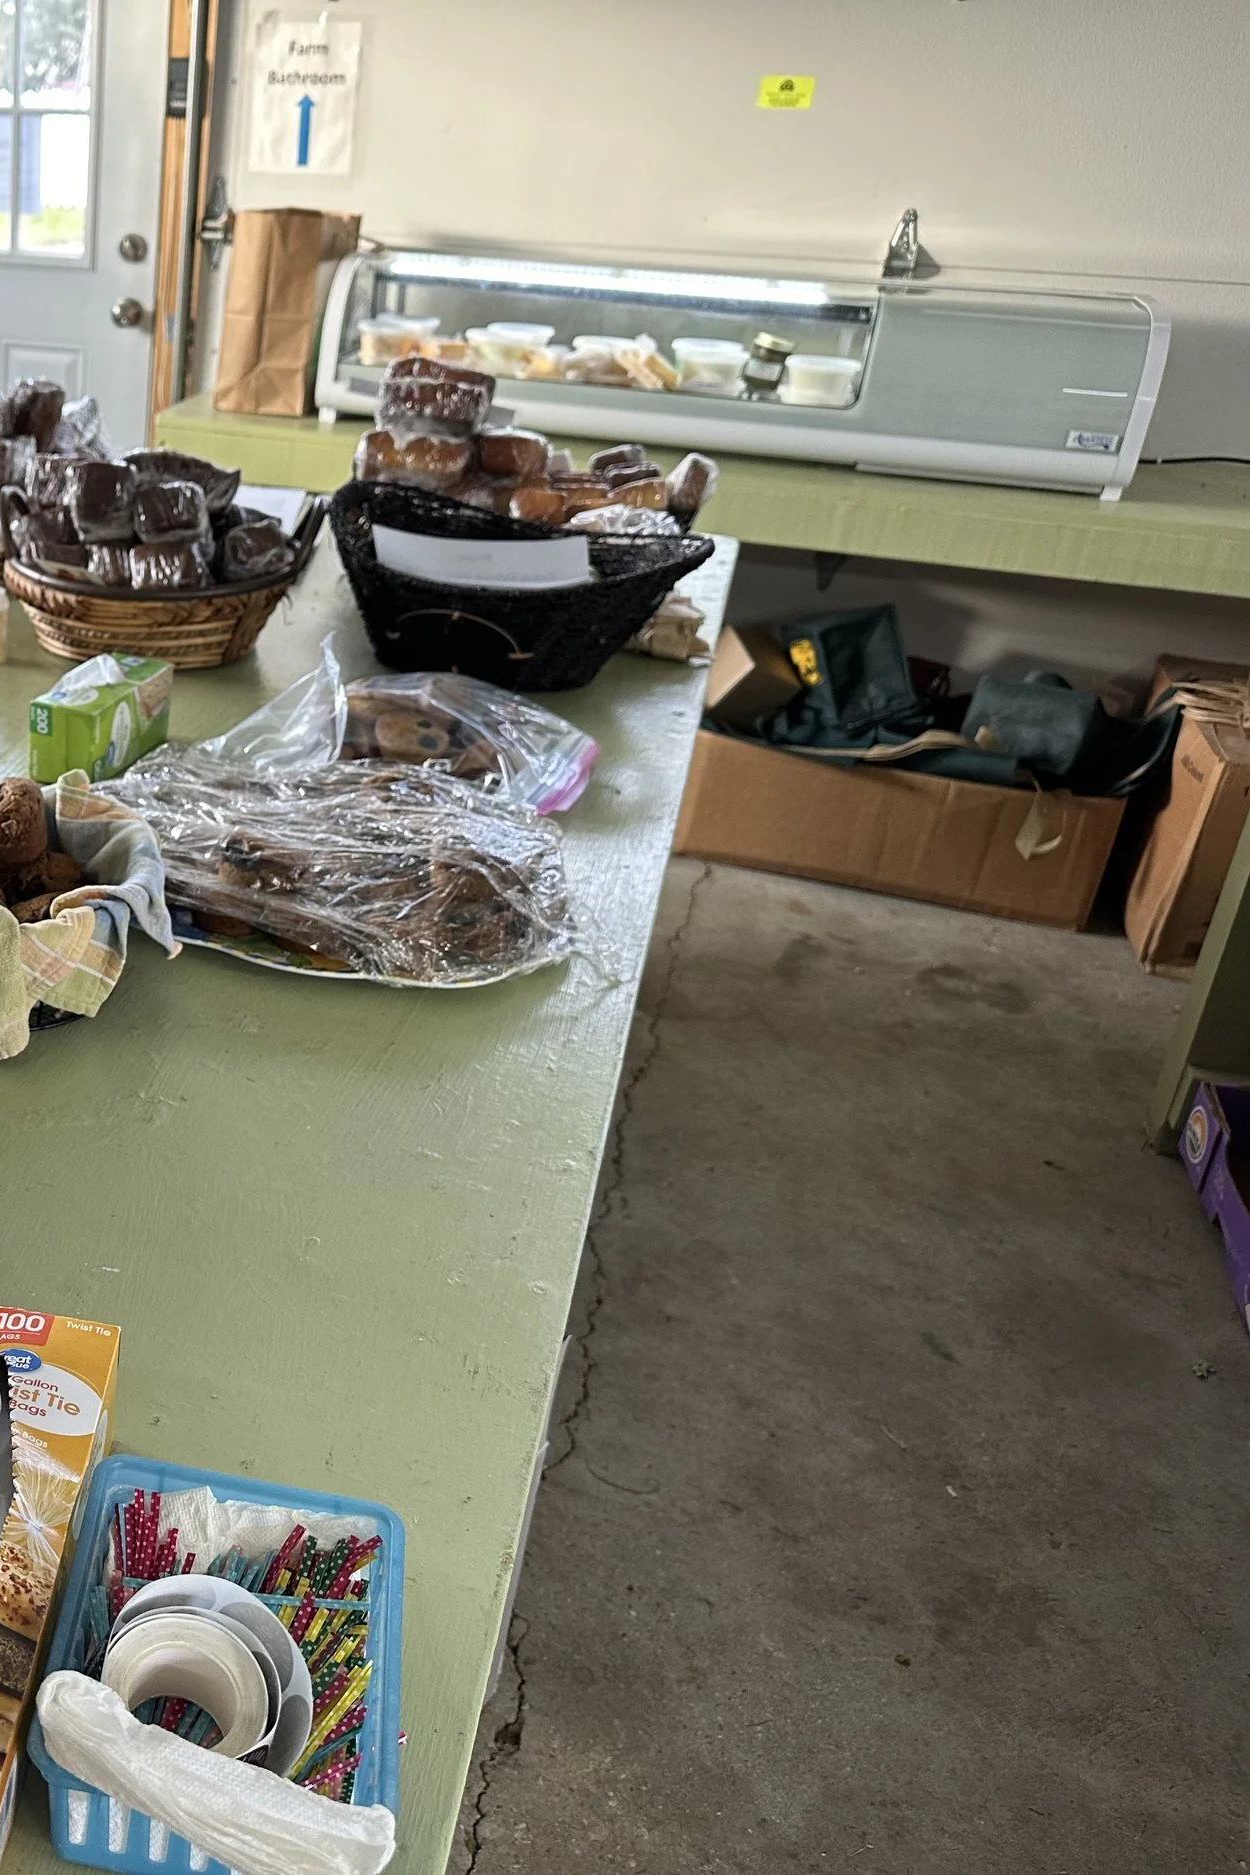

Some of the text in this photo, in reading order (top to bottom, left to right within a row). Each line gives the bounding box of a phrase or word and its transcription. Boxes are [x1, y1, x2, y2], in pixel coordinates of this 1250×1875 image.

[287, 41, 330, 56] Farm
[267, 71, 347, 85] Bathroom
[36, 708, 49, 734] 200
[65, 1320, 112, 1337] Twist Tie
[4, 1354, 32, 1365] reat
[11, 1375, 59, 1392] Gallon
[9, 1399, 47, 1417] Bags
[11, 1386, 81, 1416] ist Tie
